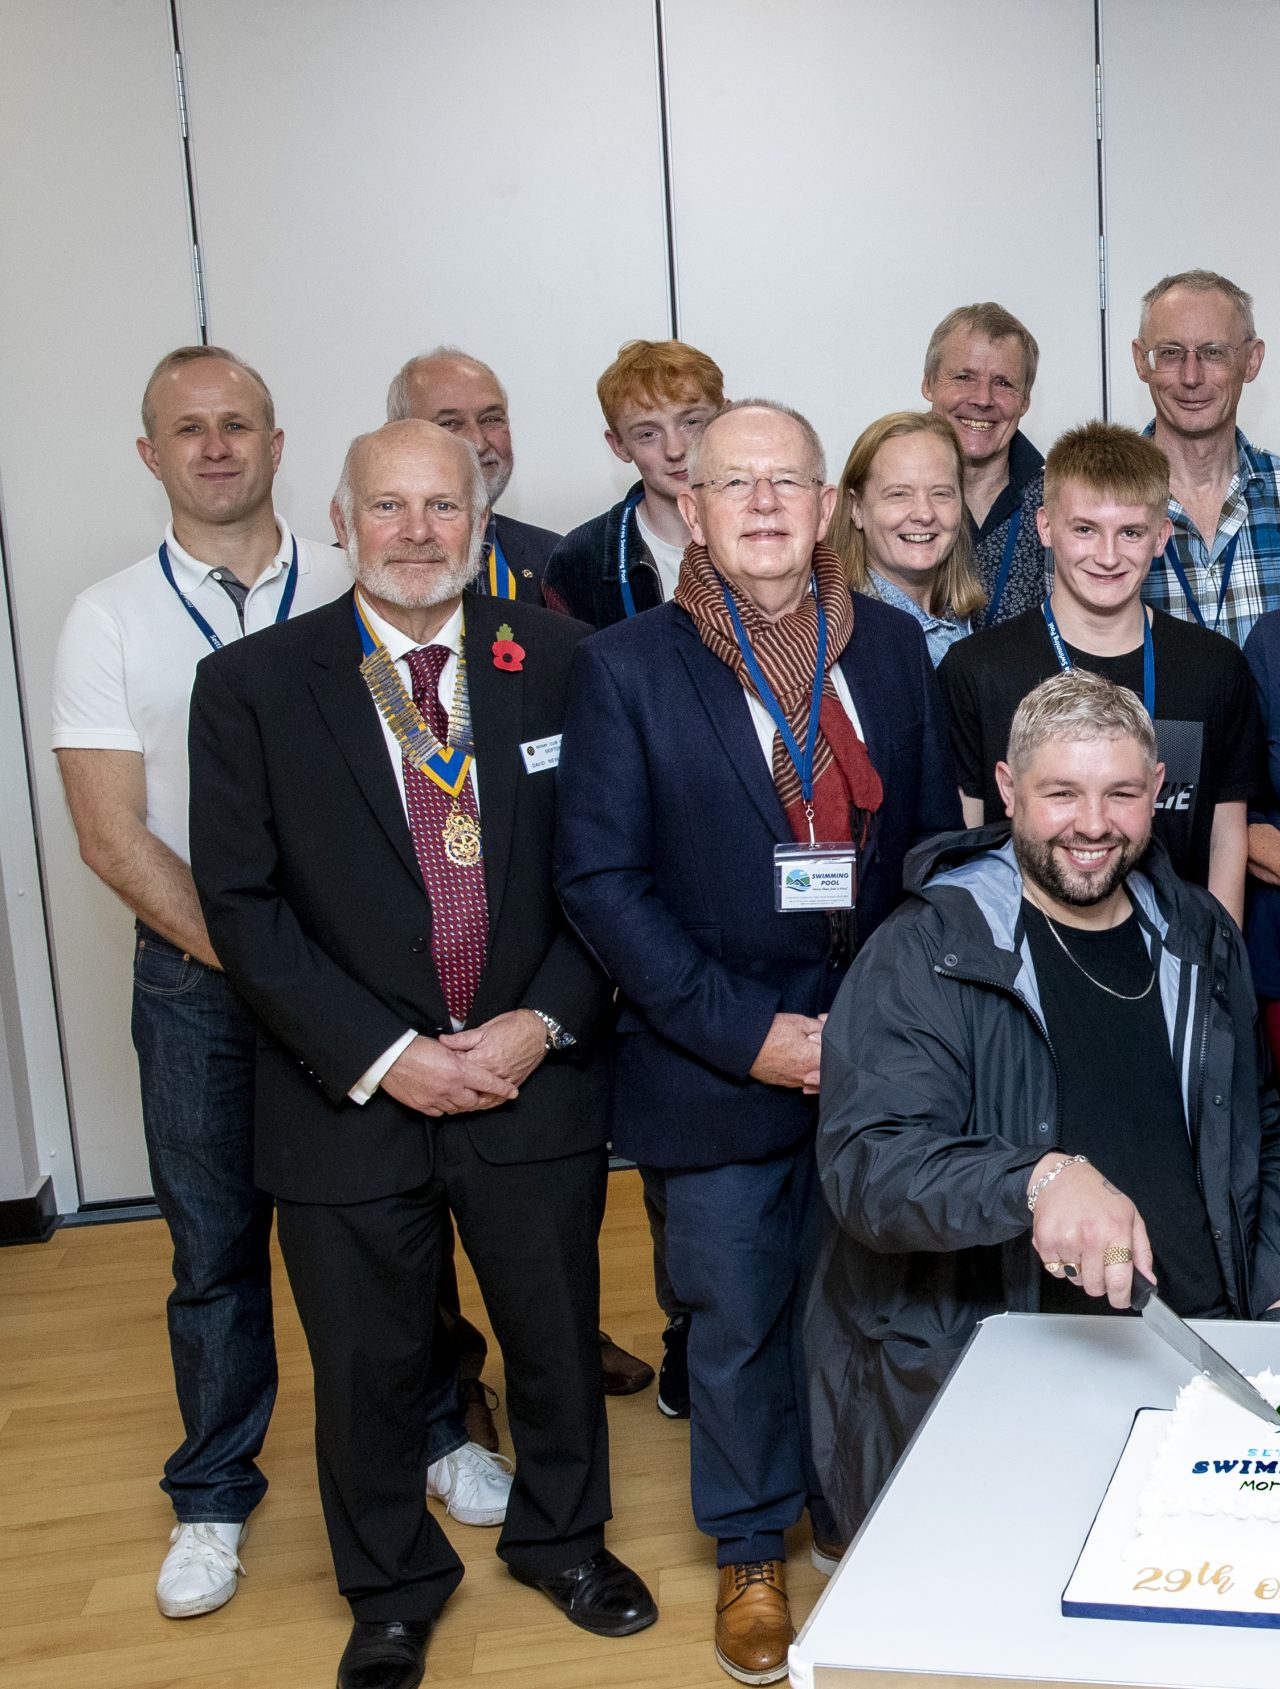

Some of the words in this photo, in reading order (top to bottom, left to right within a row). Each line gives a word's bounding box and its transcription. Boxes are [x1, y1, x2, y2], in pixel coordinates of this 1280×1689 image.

[1048, 621, 1056, 636] Pool
[210, 634, 224, 649] Settl
[812, 872, 849, 880] SWIMMING
[1132, 1561, 1236, 1595] 29th
